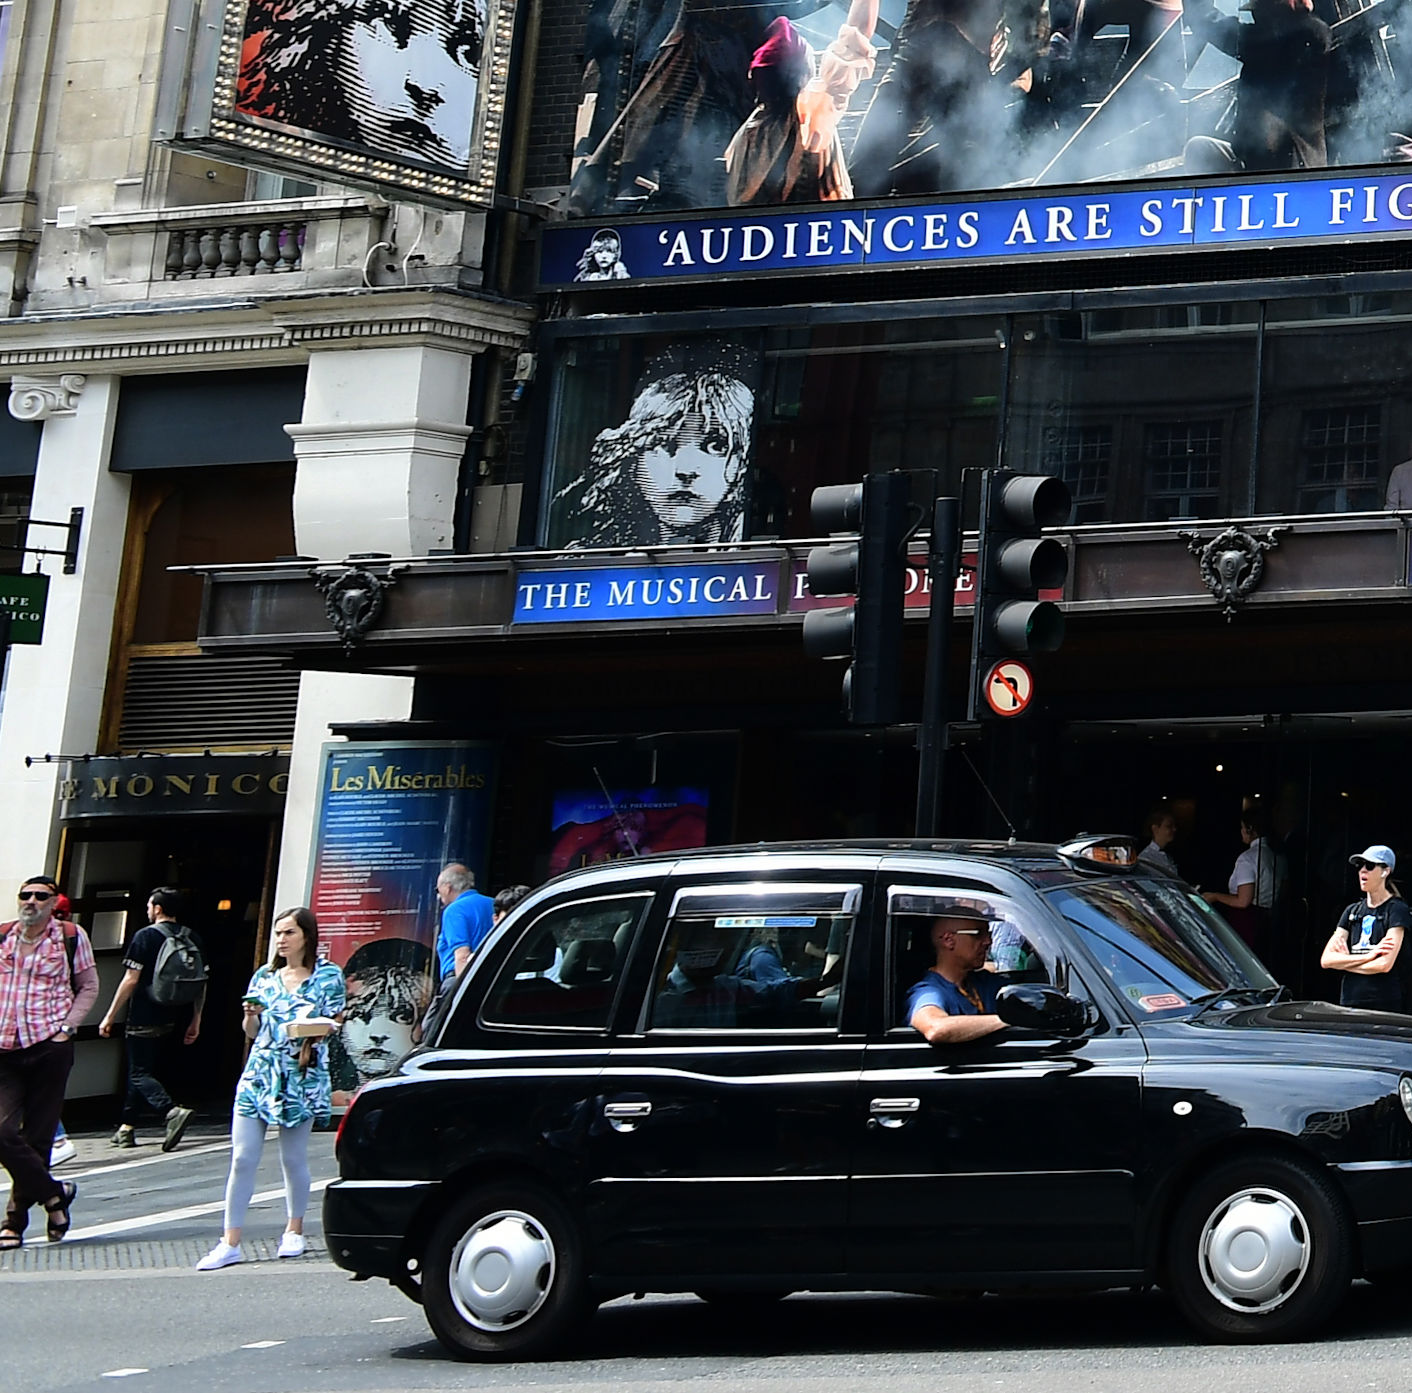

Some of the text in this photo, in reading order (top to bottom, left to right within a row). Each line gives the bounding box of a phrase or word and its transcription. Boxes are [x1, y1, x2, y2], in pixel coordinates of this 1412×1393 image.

[658, 210, 980, 268] ‘AUDIENCES
[1003, 202, 1114, 246] ARE
[1139, 190, 1300, 237] STILL
[0, 596, 30, 606] AFE
[519, 581, 592, 610] THE
[606, 574, 772, 608] MUSICAL
[9, 611, 40, 622] ICO
[90, 773, 289, 801] MONICO
[330, 764, 485, 792] Les Misérables
